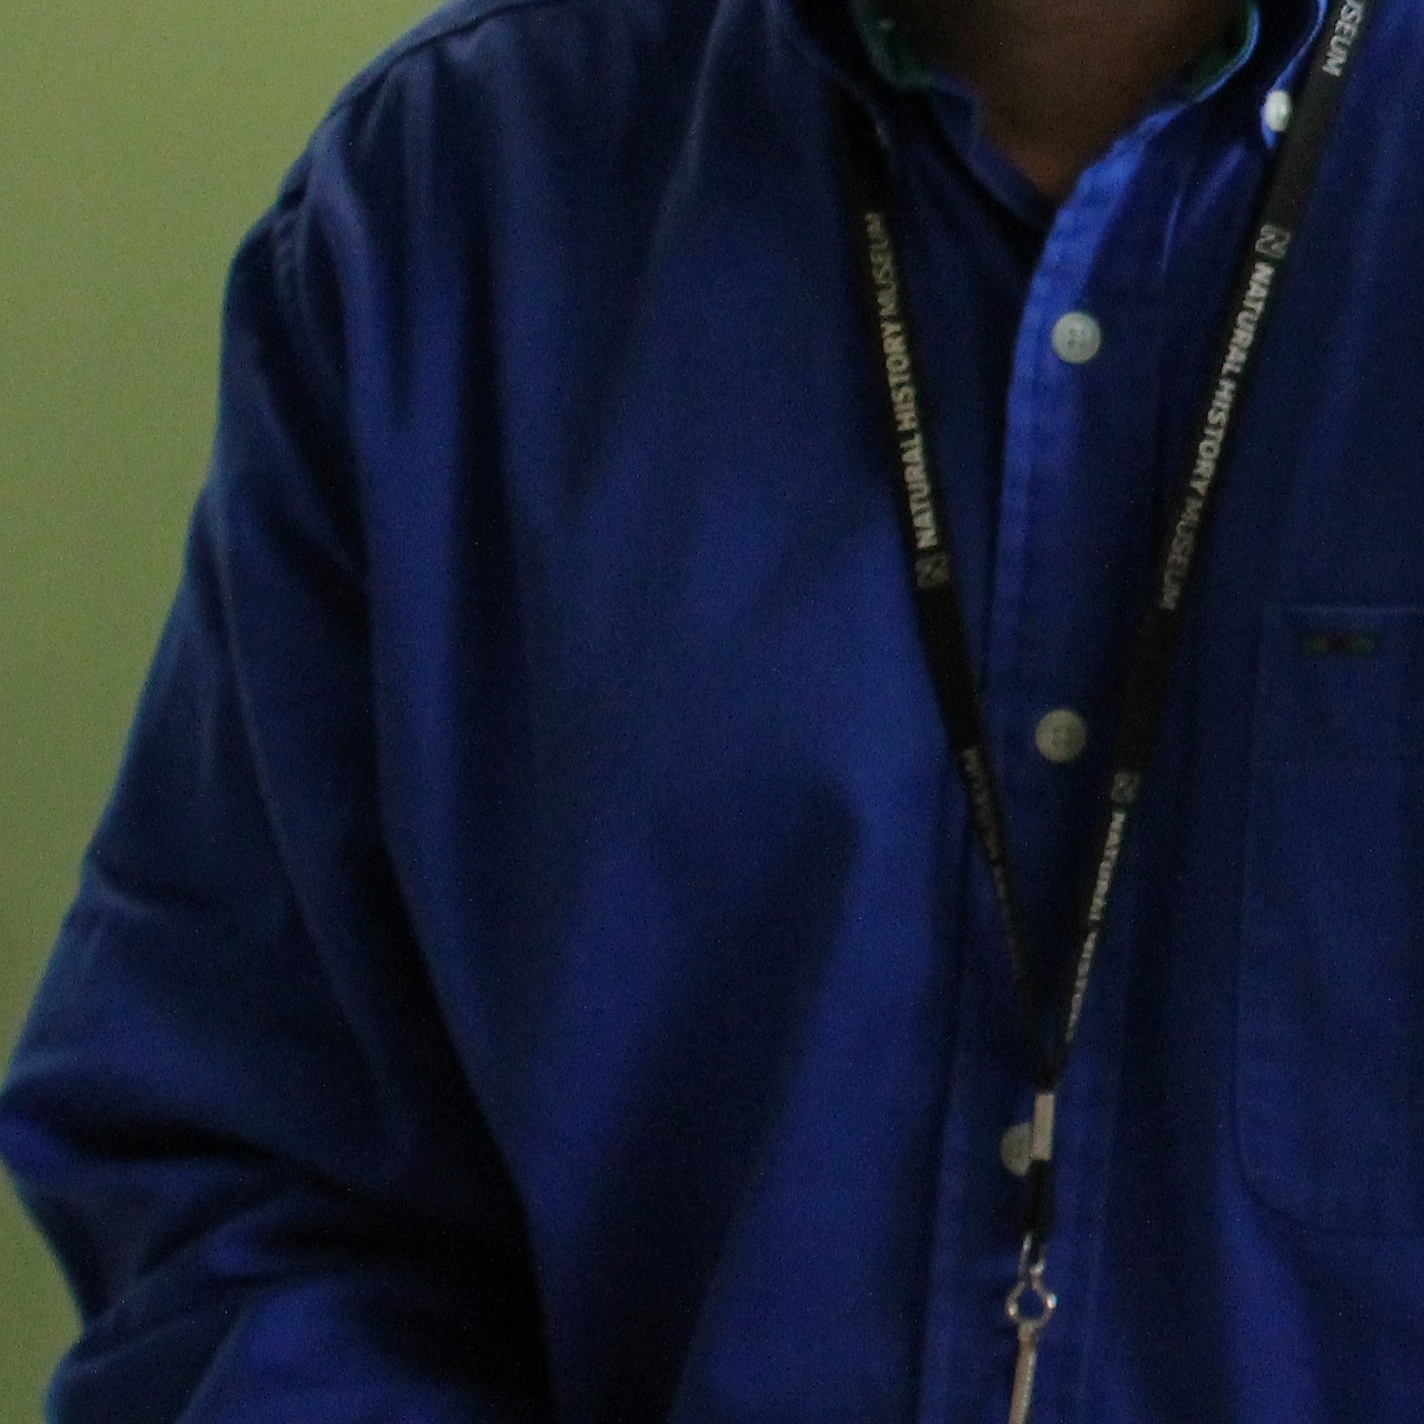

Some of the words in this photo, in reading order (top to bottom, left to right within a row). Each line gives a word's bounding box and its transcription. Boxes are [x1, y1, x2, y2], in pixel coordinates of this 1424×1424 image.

[1221, 262, 1275, 373] NATURAL
[880, 322, 919, 432] HISTORY
[900, 433, 938, 550] NATURAL
[1189, 378, 1236, 496] HISTORY
